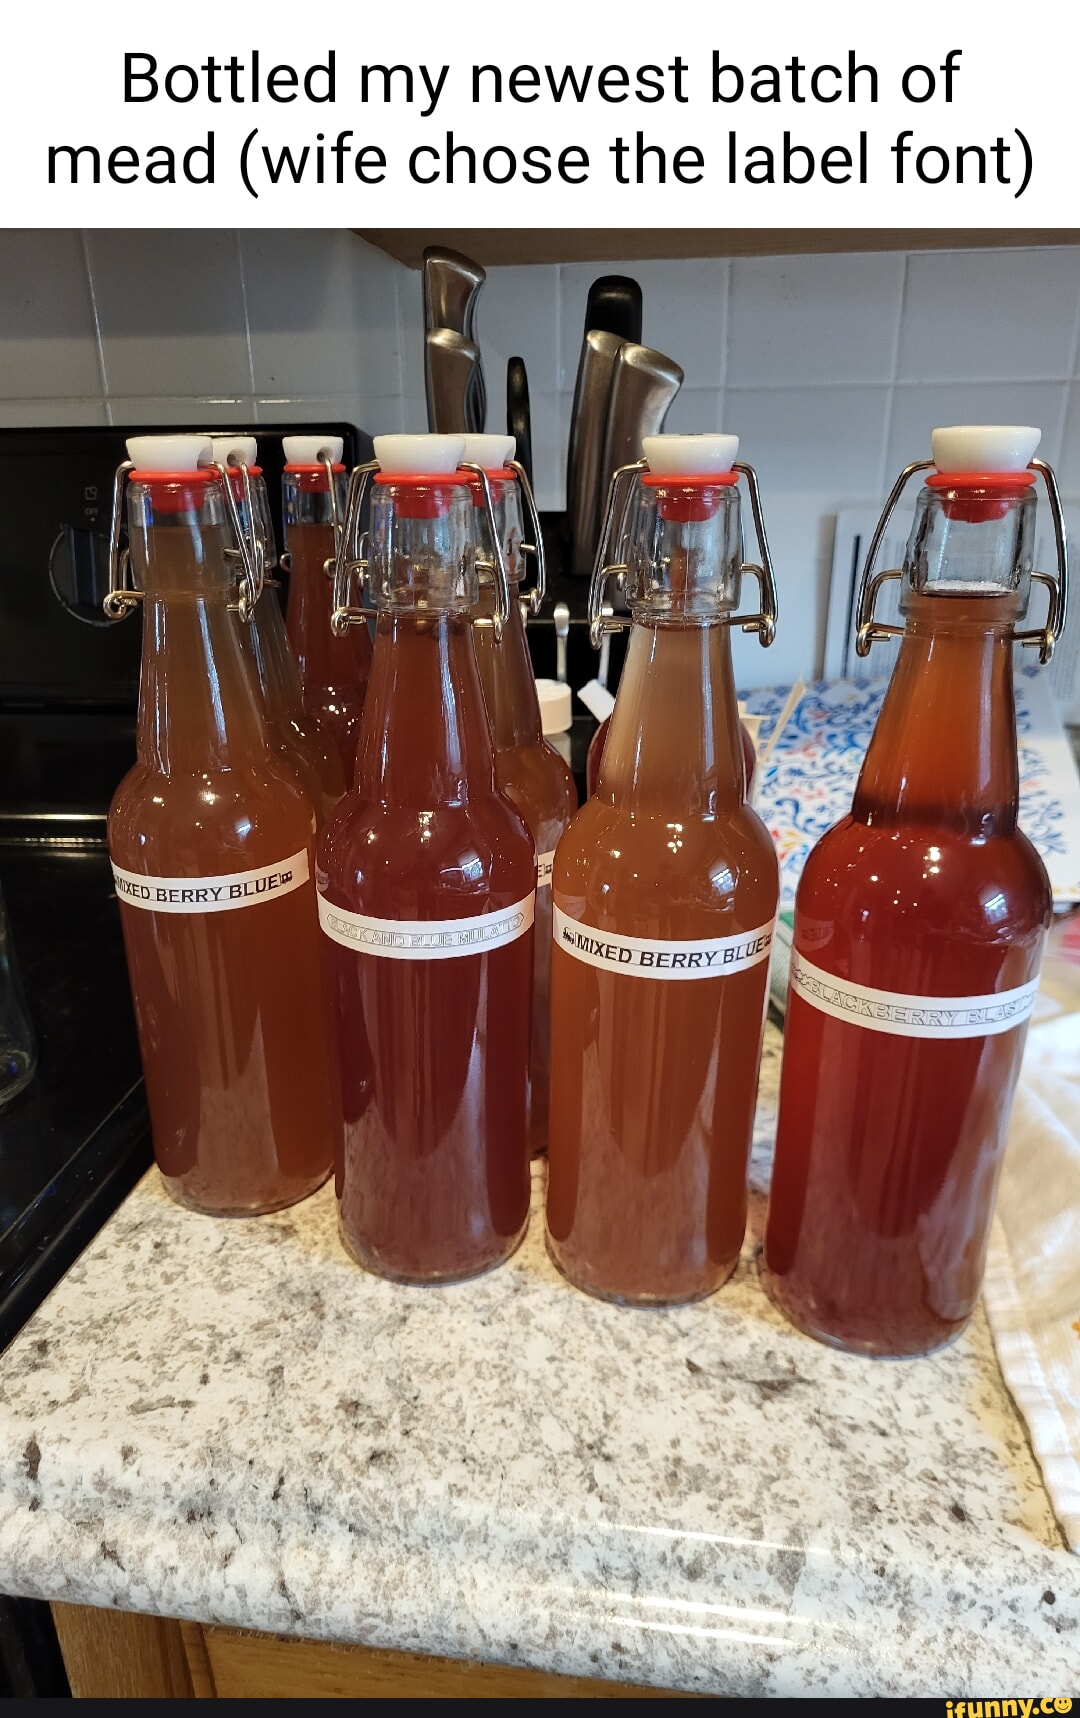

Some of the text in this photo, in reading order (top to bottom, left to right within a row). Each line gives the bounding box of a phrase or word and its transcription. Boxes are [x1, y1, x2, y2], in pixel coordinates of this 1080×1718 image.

[118, 873, 281, 903] MIXED BERRY BLUE
[370, 930, 406, 947] AND
[576, 932, 765, 968] MIXED BERRY BLUE
[810, 979, 959, 1027] BLACKBERRY
